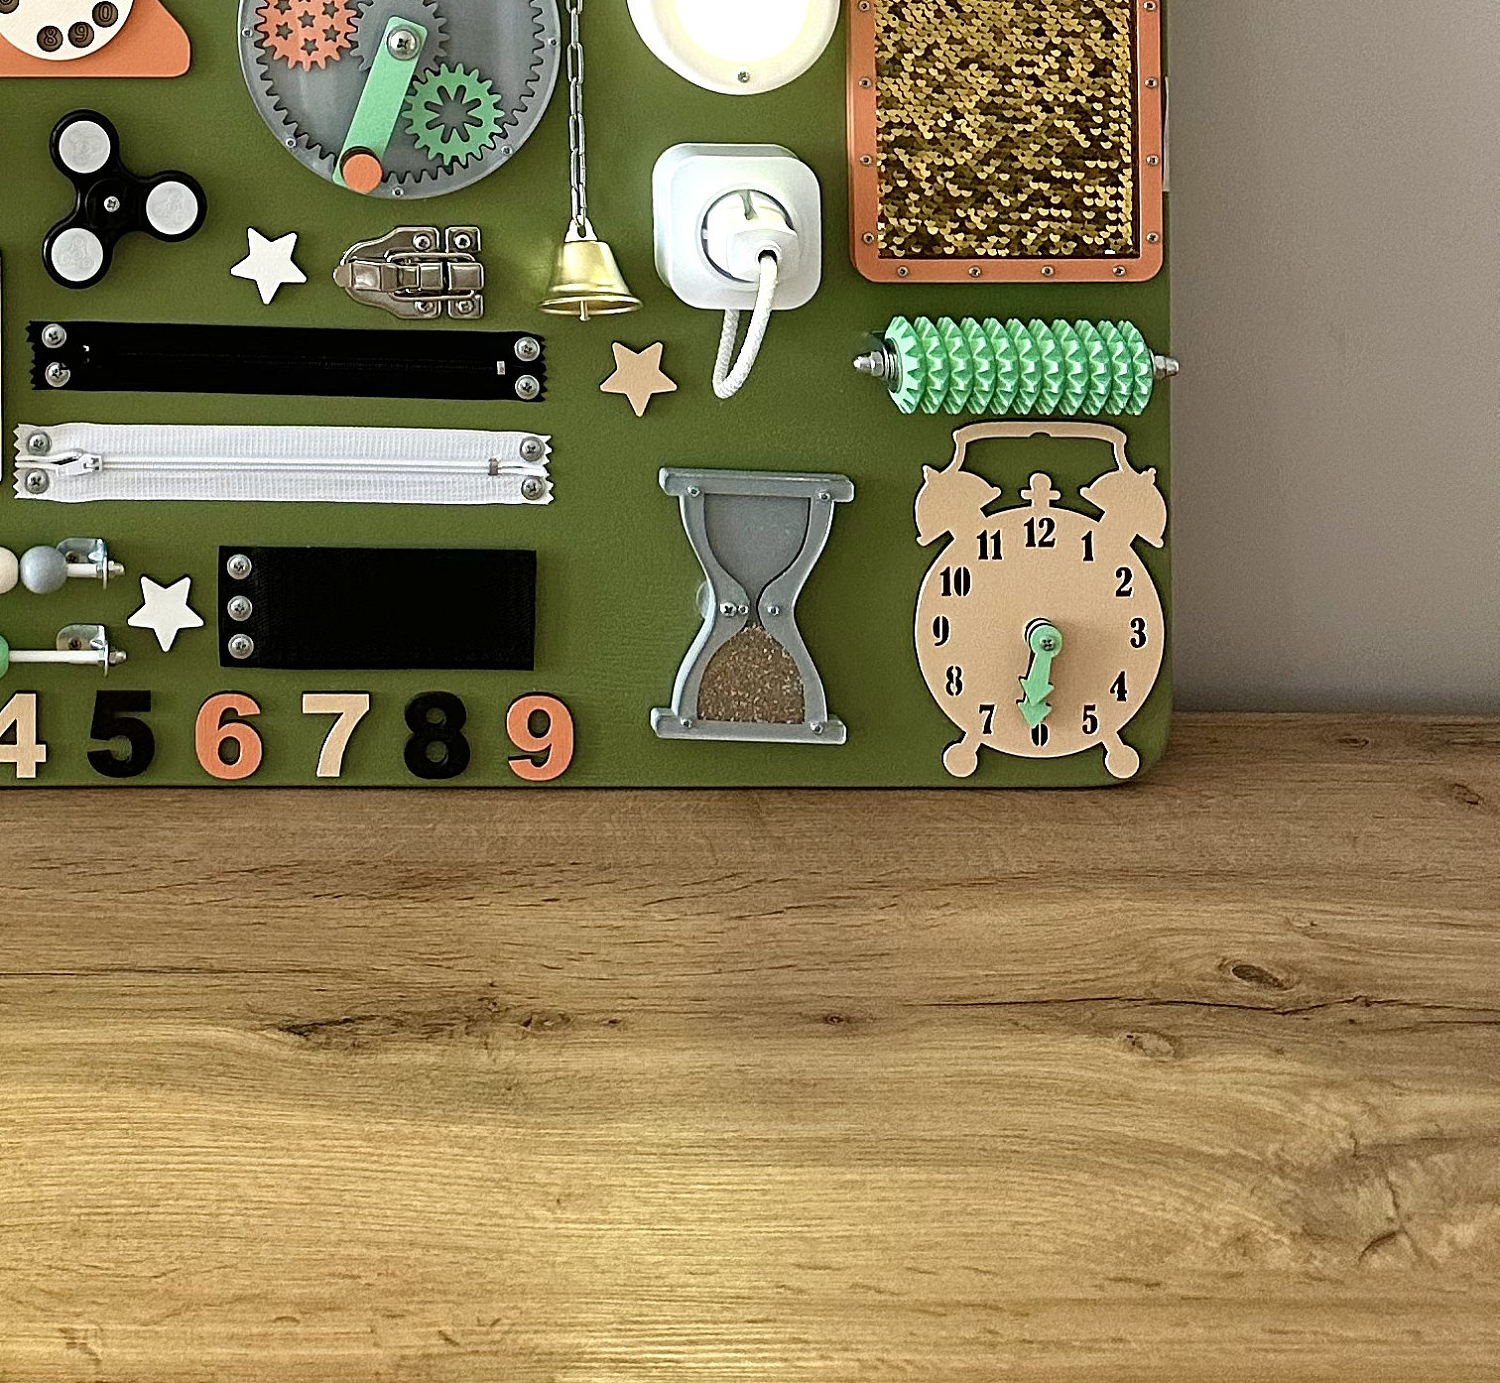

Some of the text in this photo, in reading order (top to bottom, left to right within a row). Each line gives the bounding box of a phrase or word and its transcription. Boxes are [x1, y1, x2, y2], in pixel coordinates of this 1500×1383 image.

[100, 4, 113, 22] 0
[43, 28, 57, 46] 8
[74, 24, 88, 42] 9
[977, 529, 1003, 560] 11
[1024, 517, 1056, 547] 12
[1082, 531, 1094, 561] 1
[940, 567, 971, 597] 10
[1115, 567, 1133, 597] 2
[933, 616, 950, 646] 9
[1130, 617, 1147, 648] 3
[946, 666, 963, 696] 8
[1110, 671, 1128, 702] 4
[979, 704, 996, 734] 7
[1082, 704, 1098, 734] 5
[87, 690, 155, 778] 5
[195, 691, 264, 780] 6
[302, 691, 370, 778] 7
[404, 691, 471, 779] 8
[504, 691, 575, 781] 9
